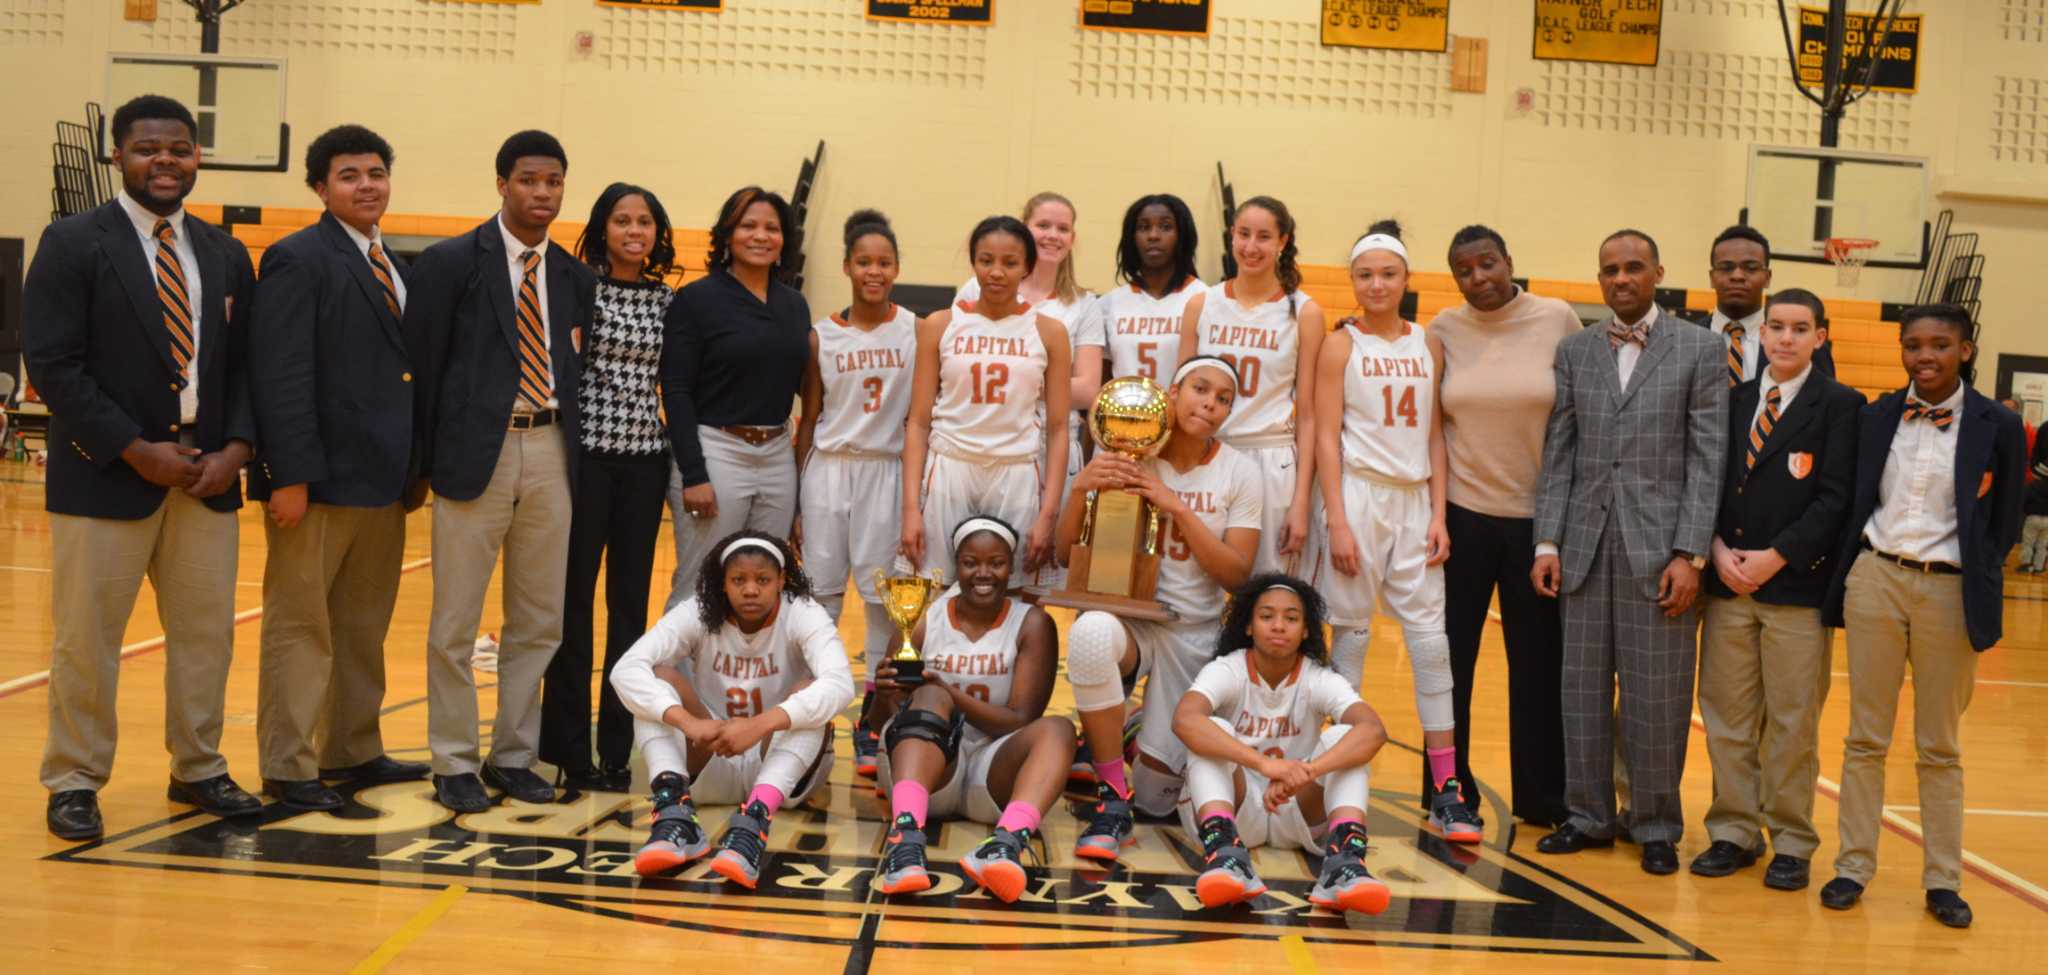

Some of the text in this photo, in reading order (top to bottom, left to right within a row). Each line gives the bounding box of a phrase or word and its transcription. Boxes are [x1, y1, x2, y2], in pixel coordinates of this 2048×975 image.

[908, 6, 951, 17] 2002
[1579, 8, 1617, 20] GOLF
[1804, 40, 1912, 60] CHMPINS
[1116, 315, 1182, 337] CAPITAL
[1208, 324, 1279, 351] CAPITAL
[954, 336, 1029, 357] CAPITAL
[1137, 341, 1158, 378] 5
[835, 348, 906, 374] CAPITAL
[1362, 356, 1428, 378] CAPITAL
[863, 376, 883, 414] 3
[970, 362, 1009, 404] 12
[1382, 385, 1418, 427] 14
[712, 651, 779, 679] CAPITAL
[934, 653, 1009, 675] CAPITAL
[726, 687, 763, 718] 21
[1235, 710, 1301, 738] CAPITAL
